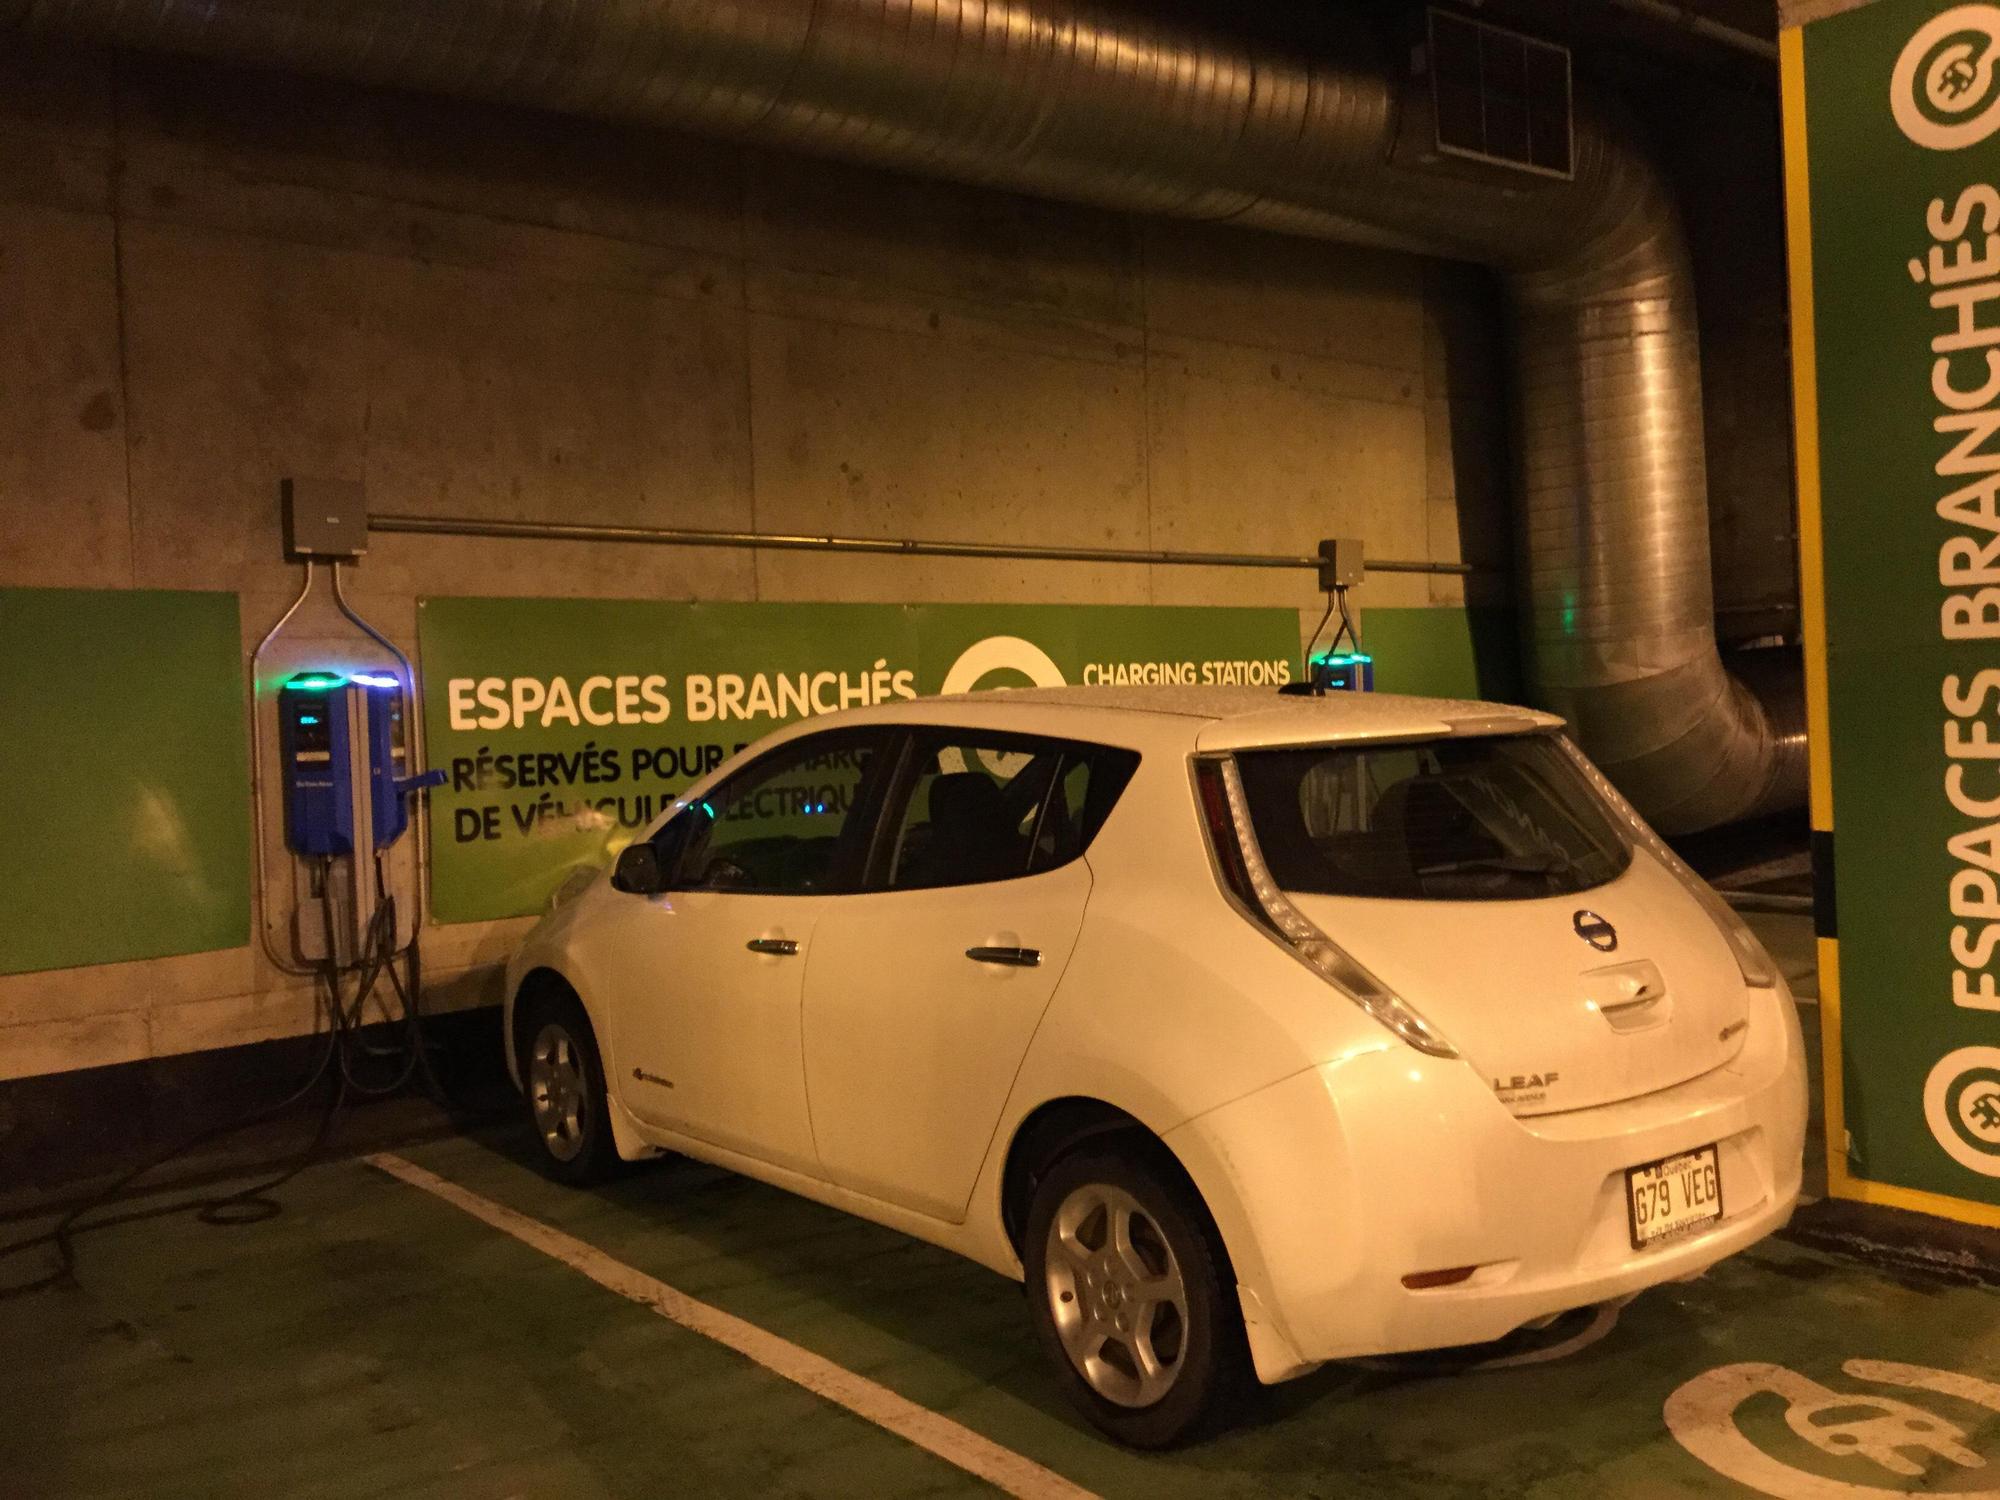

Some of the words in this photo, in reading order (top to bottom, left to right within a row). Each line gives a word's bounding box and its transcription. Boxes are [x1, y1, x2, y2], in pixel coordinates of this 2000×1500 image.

[1907, 183, 2000, 640] BRANCHÉS
[449, 675, 671, 731] ESPACES
[686, 658, 917, 722] BRANCHÉS
[1083, 662, 1197, 686] CHARGING
[1201, 659, 1291, 686] STATIONS
[452, 741, 621, 792] RÉSERVÉS
[632, 744, 724, 781] POUR
[455, 805, 502, 843] DE
[511, 792, 677, 838] VÉCULE
[725, 783, 857, 822] LECTRIQU
[1941, 668, 2000, 1012] ESPACES
[1493, 1072, 1559, 1091] LEAF
[1635, 1179, 1672, 1225] G79
[1681, 1164, 1716, 1209] VEG
